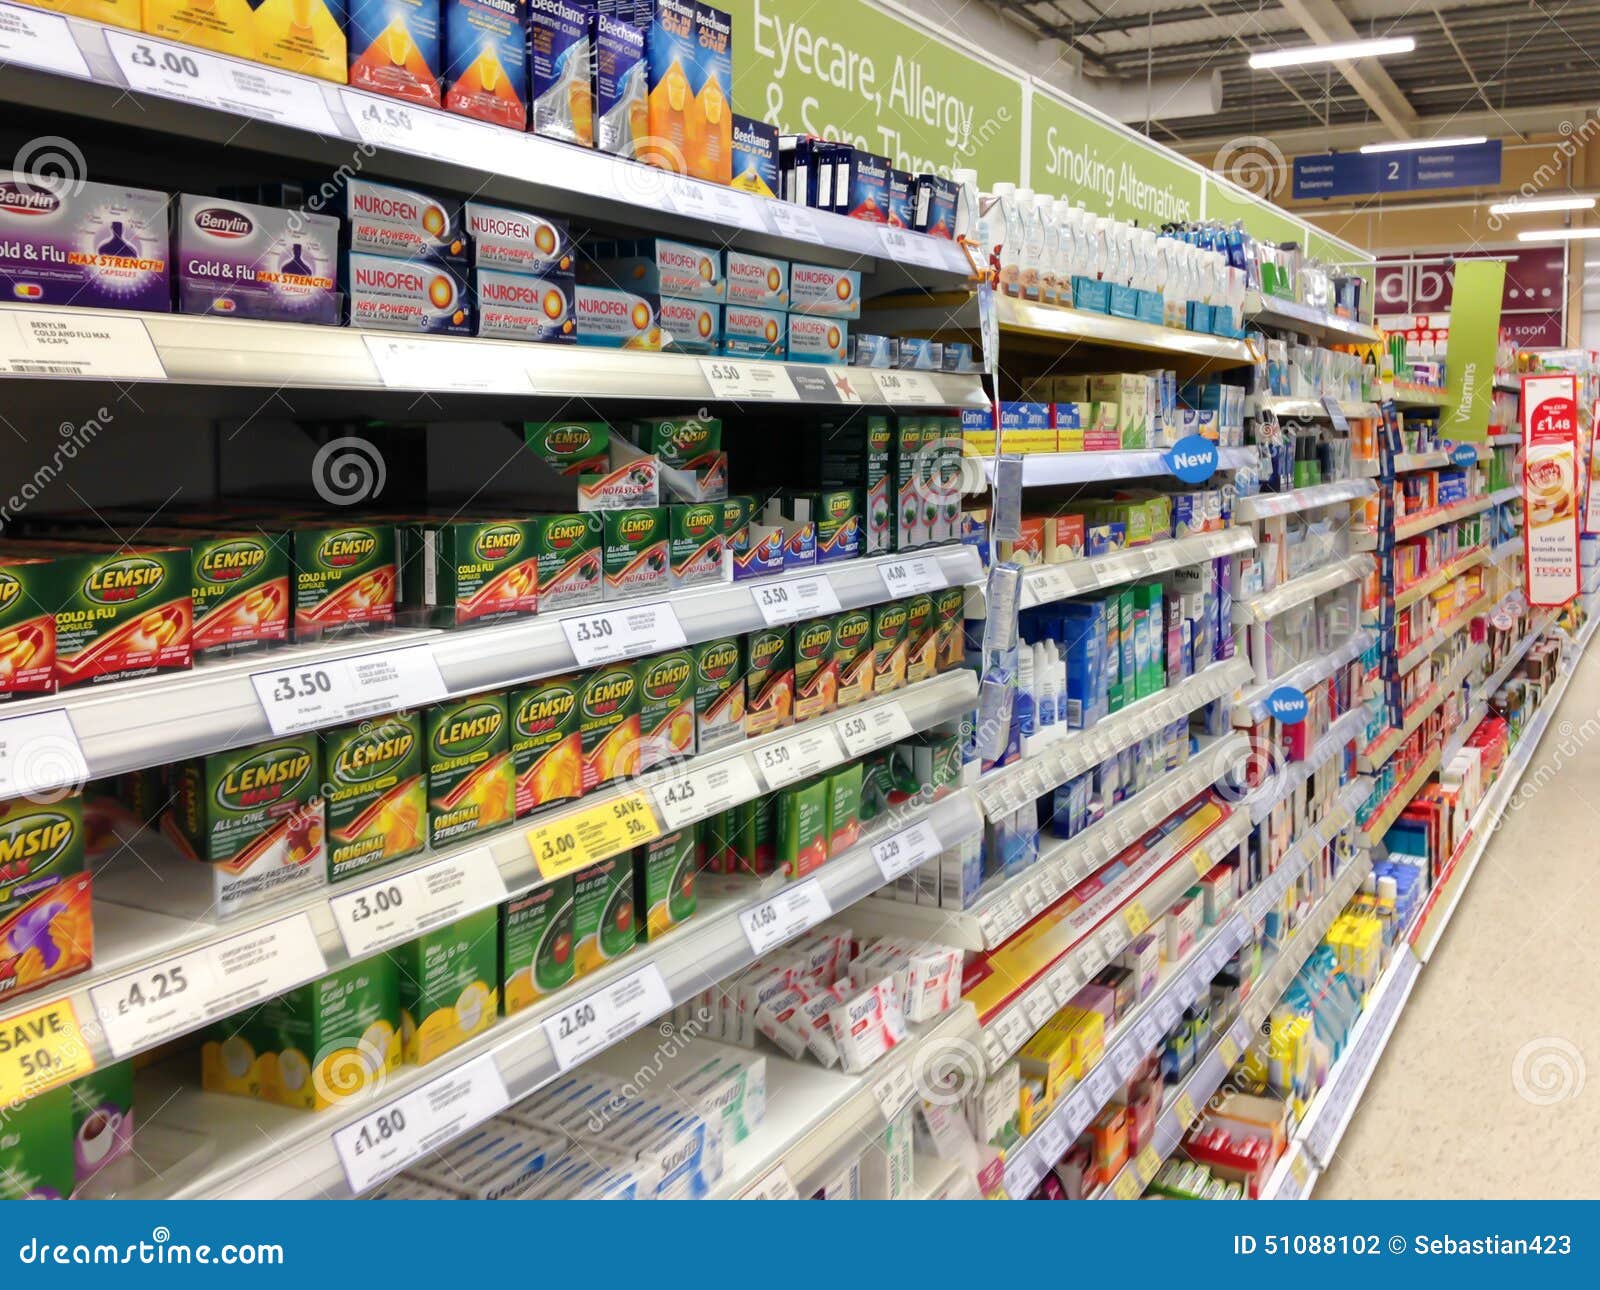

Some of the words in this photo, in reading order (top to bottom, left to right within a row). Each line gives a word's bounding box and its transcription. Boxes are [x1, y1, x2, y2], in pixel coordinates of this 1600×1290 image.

[532, 0, 584, 25] Beechams
[599, 15, 643, 47] Beechams
[697, 11, 730, 34] Beechams
[131, 44, 199, 78] £3.00
[754, 0, 881, 116] Eyecare,
[889, 55, 974, 151] Allergy
[734, 127, 770, 148] Beechams
[1046, 127, 1115, 207] Smoking
[1117, 162, 1191, 222] Alternatives
[1387, 162, 1399, 180] 2
[0, 187, 54, 208] Benylin
[354, 195, 417, 220] NUROFEN
[201, 214, 248, 232] Benylin
[471, 216, 529, 239] NUROFEN
[358, 225, 378, 236] NEW
[381, 229, 423, 244] POWERFUL
[23, 244, 38, 260] &
[42, 246, 65, 263] Flu
[68, 252, 97, 265] MAX
[99, 256, 164, 272] STRENGTH
[480, 245, 497, 254] NEW
[500, 247, 535, 260] POWERFUL
[659, 252, 696, 269] NUROFEN
[100, 269, 137, 279] CAPSULES
[189, 260, 220, 276] Cold
[222, 263, 234, 279] &
[236, 264, 255, 280] Flu
[256, 271, 279, 283] MAX
[282, 273, 333, 289] STRENGTH
[356, 269, 423, 291] NUROFEN
[730, 263, 764, 278] NUROFEN
[795, 271, 834, 285] NUROFEN
[281, 285, 311, 294] CAPSULES
[483, 284, 538, 304] NUROFEN
[357, 301, 376, 311] NEW
[379, 302, 423, 316] POWERFUL
[579, 298, 627, 315] NUROFEN
[661, 306, 695, 320] NUROFEN
[31, 321, 67, 330] BENYLIN
[485, 313, 500, 321] NEW
[503, 314, 539, 326] POWERFUL
[729, 313, 763, 328] NUROFEN
[34, 329, 57, 338] COLD
[77, 331, 92, 339] FLU
[93, 332, 111, 340] MAX
[1515, 326, 1546, 336] soon
[1456, 363, 1477, 423] Vitamins
[1537, 416, 1570, 431] £1.48
[1174, 451, 1213, 470] New
[1455, 450, 1475, 461] New
[602, 487, 614, 495] NO
[831, 499, 850, 513] LEMSIP
[621, 519, 655, 533] LEMSIP
[686, 514, 714, 527] LEMSIP
[478, 535, 521, 549] LEMSIP
[548, 525, 585, 540] LEMSIP
[323, 539, 375, 556] LEMSIP
[800, 549, 815, 559] NIGHT
[844, 541, 859, 551] NIGHT
[203, 550, 264, 570] LEMSIP
[458, 564, 476, 574] COLD
[483, 563, 494, 572] FLU
[767, 556, 784, 566] NIGHT
[90, 567, 163, 591] LEMSIP
[298, 573, 320, 584] COLD
[327, 571, 341, 580] FLU
[1174, 569, 1199, 580] ReNu
[207, 585, 225, 595] FLU
[762, 587, 787, 605] £3.50
[56, 611, 86, 625] COLD
[96, 608, 117, 620] FLU
[879, 612, 907, 629] LEMSIP
[56, 621, 93, 633] CAPSULES
[577, 619, 612, 642] £3.50
[838, 620, 869, 639] LEMSIP
[752, 639, 784, 657] LEMSIP
[802, 630, 832, 648] LEMSIP
[701, 649, 738, 670] LEMSIP
[647, 664, 690, 688] LEMSIP
[274, 670, 331, 702] £3.50
[586, 679, 634, 705] LEMSIP
[520, 694, 575, 723] LEMSIP
[1273, 699, 1304, 713] New
[439, 713, 501, 746] LEMSIP
[340, 734, 413, 771] LEMSIP
[225, 754, 312, 795] LEMSIP
[240, 785, 283, 807] MAX
[665, 780, 695, 807] £4.25
[434, 806, 480, 829] ORIGINAL
[613, 798, 644, 819] SAVE
[213, 819, 231, 832] ALL
[242, 811, 265, 825] ONE
[434, 820, 479, 841] STRENGTH
[626, 818, 646, 835] 50p
[0, 820, 72, 864] MSIP
[333, 836, 385, 863] ORIGINAL
[542, 833, 575, 860] £3.00
[333, 851, 384, 875] STRENGTH
[352, 886, 403, 923] £3.00
[117, 966, 188, 1017] £4.25
[0, 1011, 62, 1051] SAVE
[559, 1004, 595, 1039] £2.60
[20, 1048, 62, 1078] 50p
[355, 1108, 406, 1156] £1.80
